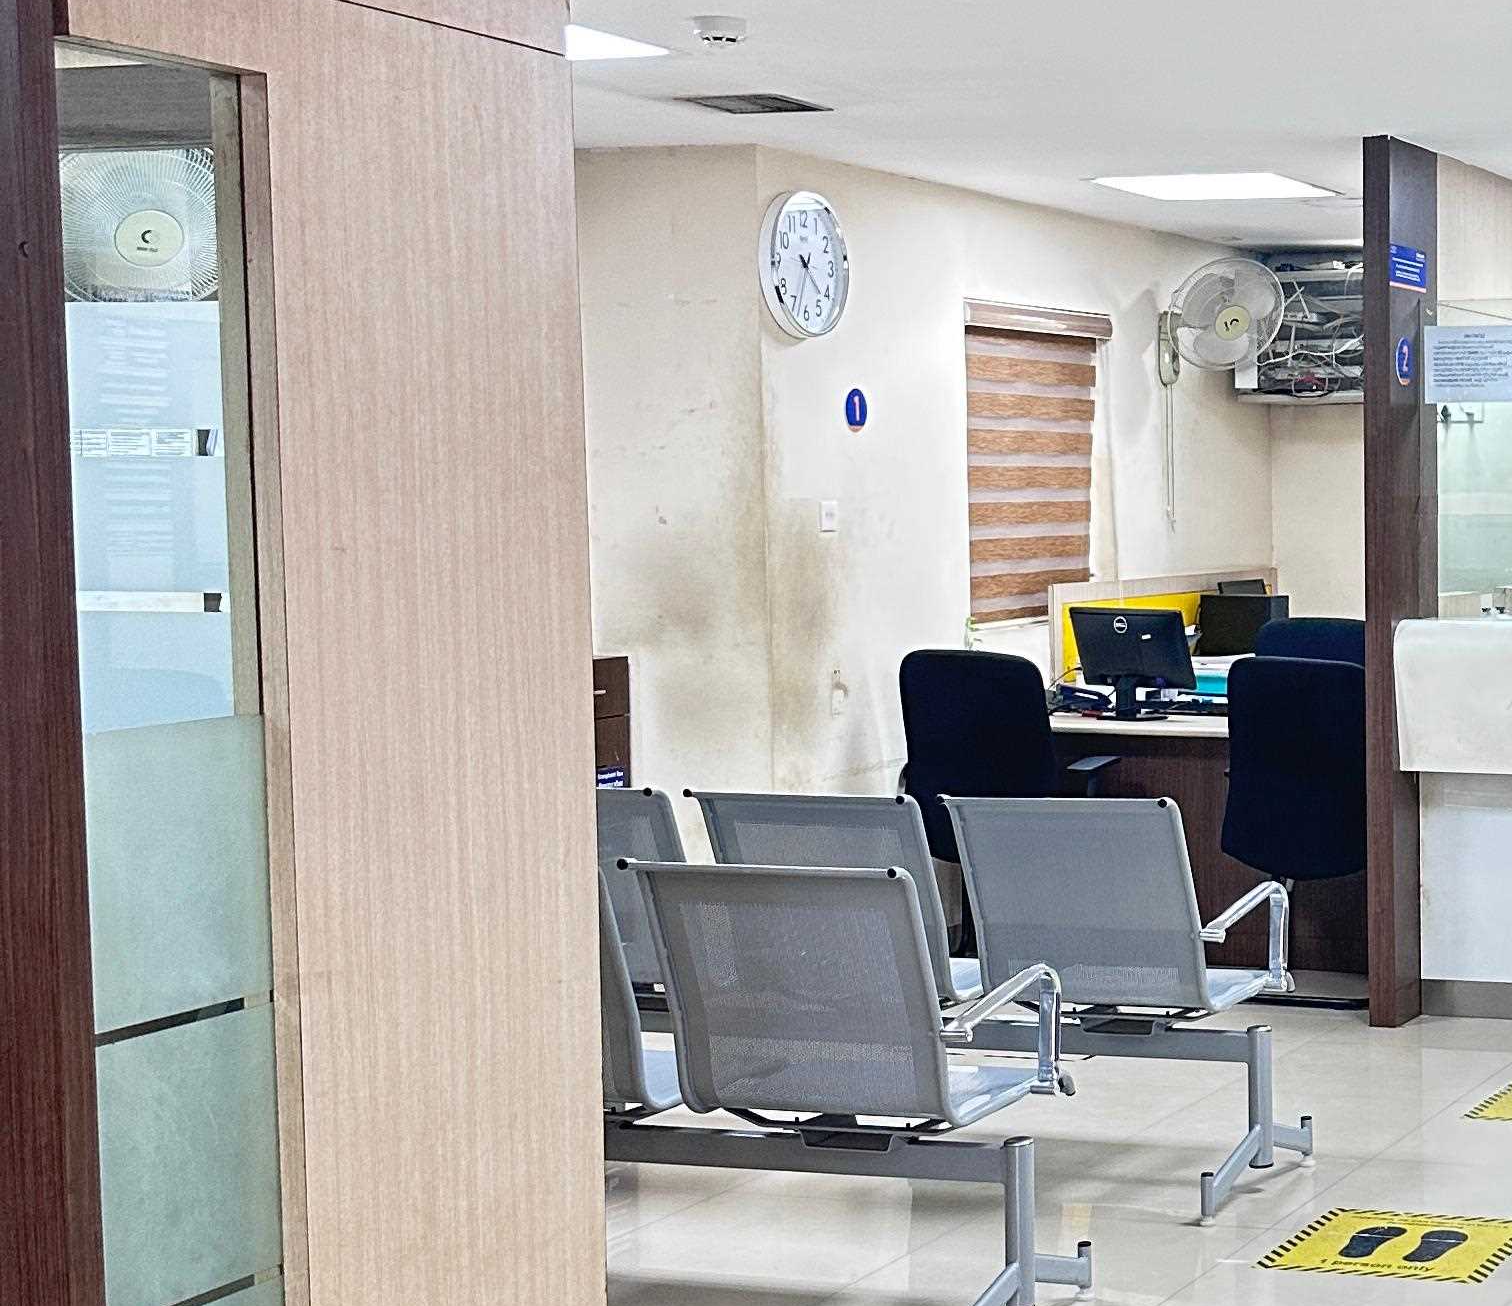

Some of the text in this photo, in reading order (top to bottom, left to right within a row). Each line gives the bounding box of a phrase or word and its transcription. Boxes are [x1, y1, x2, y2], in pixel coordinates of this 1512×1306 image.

[788, 214, 796, 234] 11
[779, 230, 790, 250] 10
[822, 235, 829, 254] 2
[827, 260, 835, 278] 3
[780, 277, 788, 296] 8
[823, 284, 830, 301] 4
[790, 294, 797, 313] 7
[803, 304, 810, 322] 6
[815, 298, 822, 317] 5
[1402, 345, 1409, 372] 2
[1331, 1260, 1393, 1269] person
